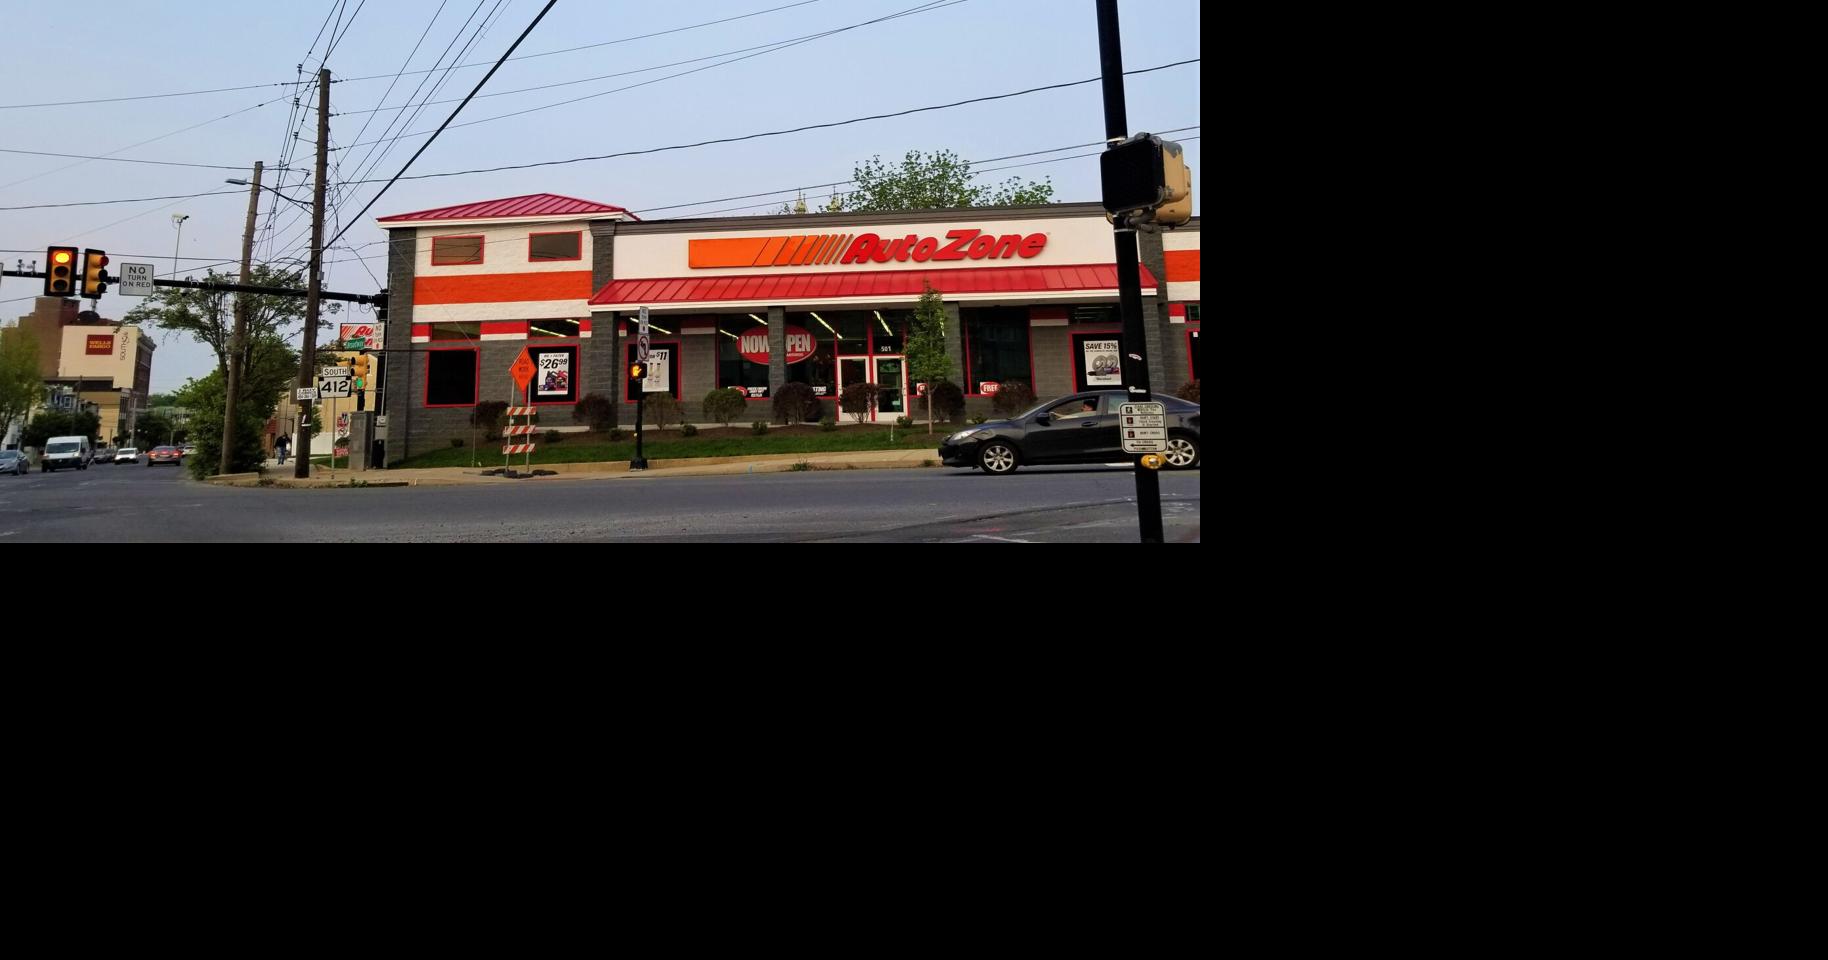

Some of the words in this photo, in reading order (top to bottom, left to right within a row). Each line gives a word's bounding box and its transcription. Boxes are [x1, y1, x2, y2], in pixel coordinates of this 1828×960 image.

[840, 228, 1048, 265] AutoZone
[128, 266, 146, 275] NO
[741, 335, 769, 353] NOW
[785, 334, 811, 352] PEN
[1085, 342, 1103, 350] SAVE
[1103, 342, 1118, 350] 15%
[324, 368, 347, 376] SOUTH
[320, 380, 348, 392] 412
